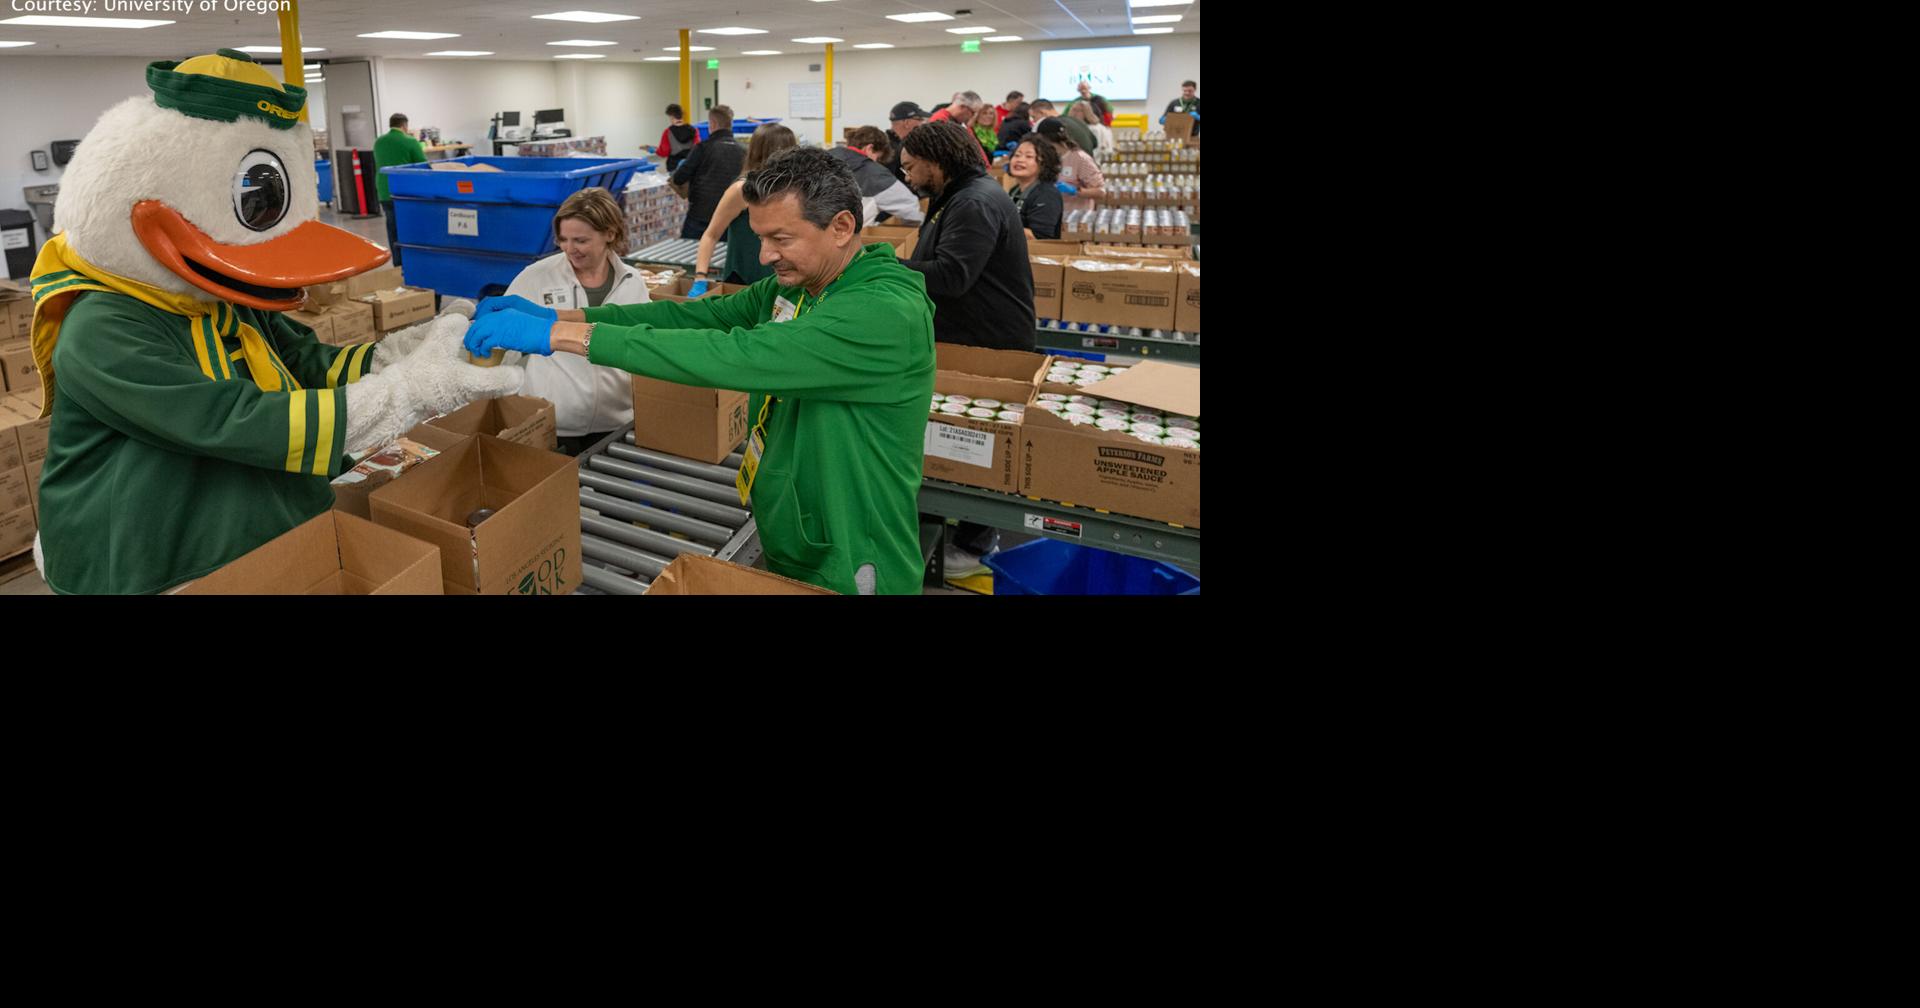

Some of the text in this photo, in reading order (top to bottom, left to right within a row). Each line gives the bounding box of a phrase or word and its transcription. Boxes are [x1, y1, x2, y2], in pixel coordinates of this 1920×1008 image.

[1094, 459, 1167, 477] UNSWEETENED
[1096, 466, 1164, 483] APPLE SAUCE
